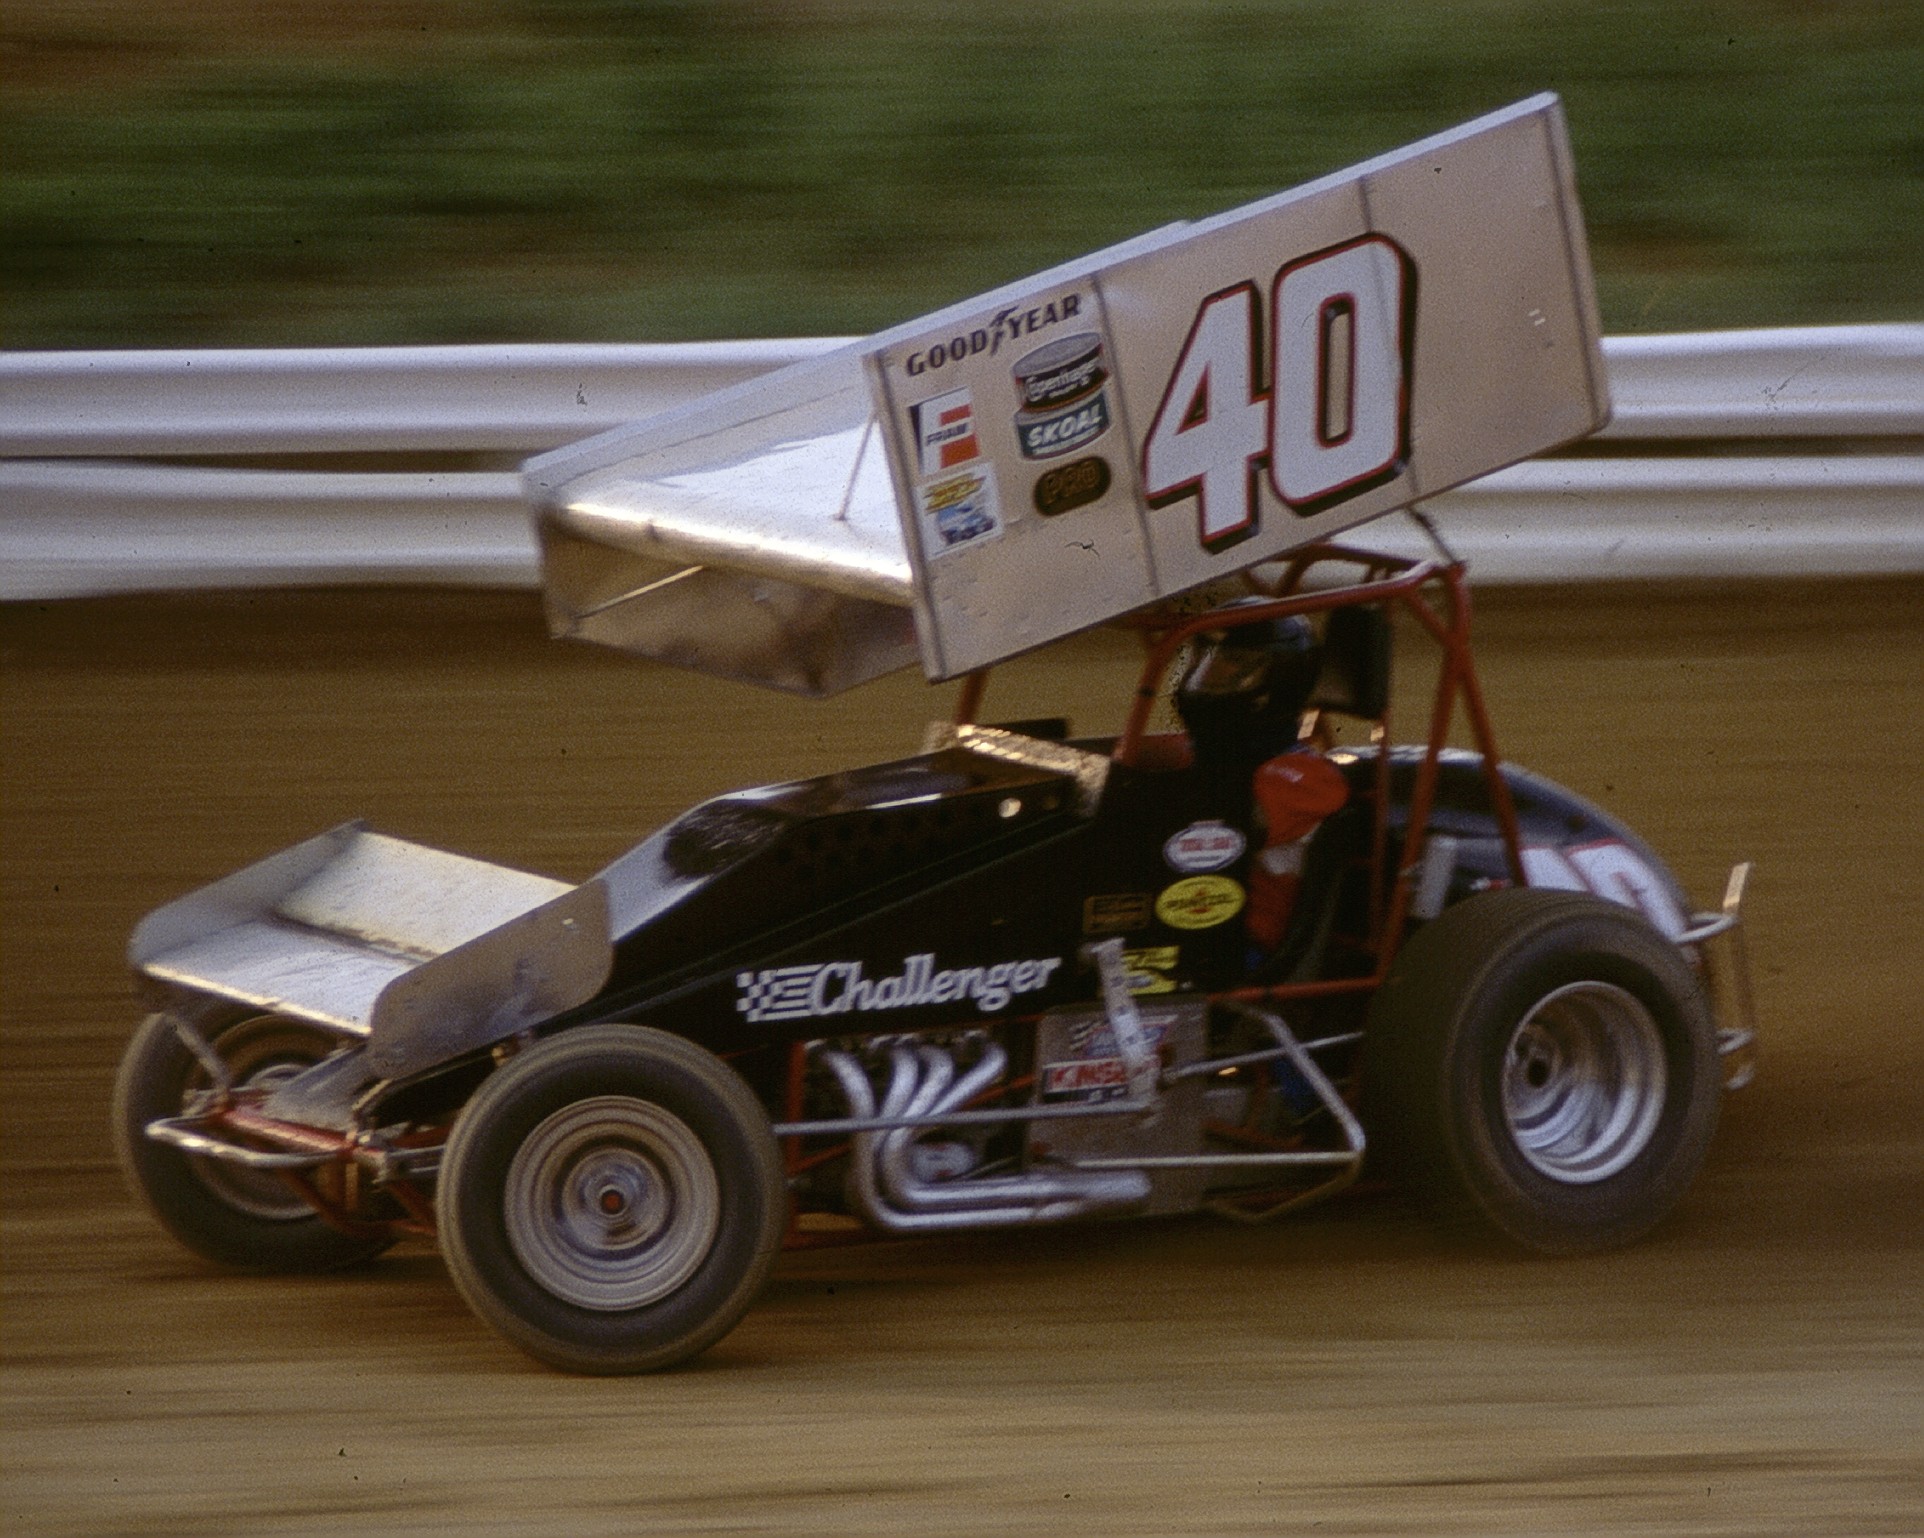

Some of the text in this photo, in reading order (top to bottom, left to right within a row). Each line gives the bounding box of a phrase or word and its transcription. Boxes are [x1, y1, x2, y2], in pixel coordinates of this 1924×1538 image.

[907, 293, 1081, 376] GOODYEAR
[1027, 403, 1102, 447] SKOAL
[1143, 231, 1418, 554] 40
[810, 952, 1062, 1016] Challenger
